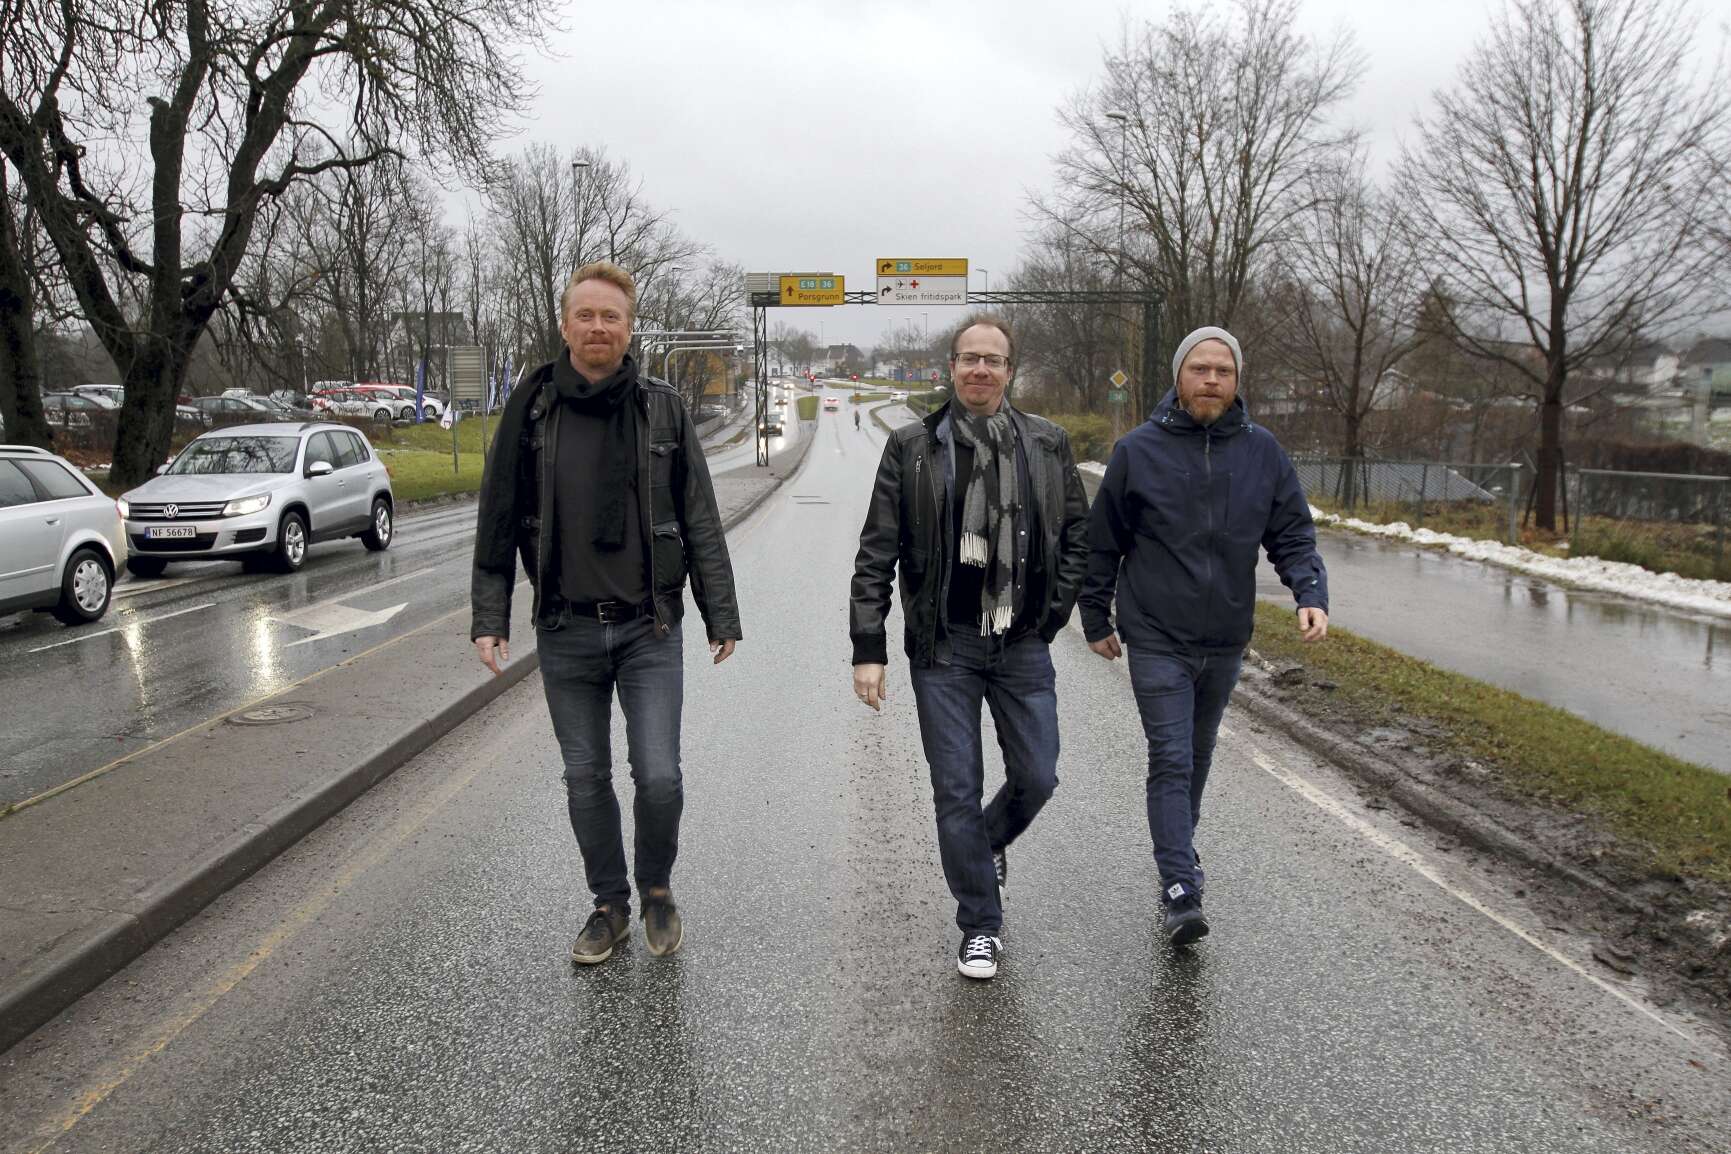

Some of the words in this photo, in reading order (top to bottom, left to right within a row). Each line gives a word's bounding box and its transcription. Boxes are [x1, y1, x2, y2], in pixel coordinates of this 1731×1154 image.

[914, 262, 943, 272] Seljord
[798, 293, 840, 303] Porsgrunn
[895, 293, 918, 301] Skien
[921, 292, 962, 302] fritidspark
[152, 528, 163, 537] NF
[166, 528, 193, 537] 56678
